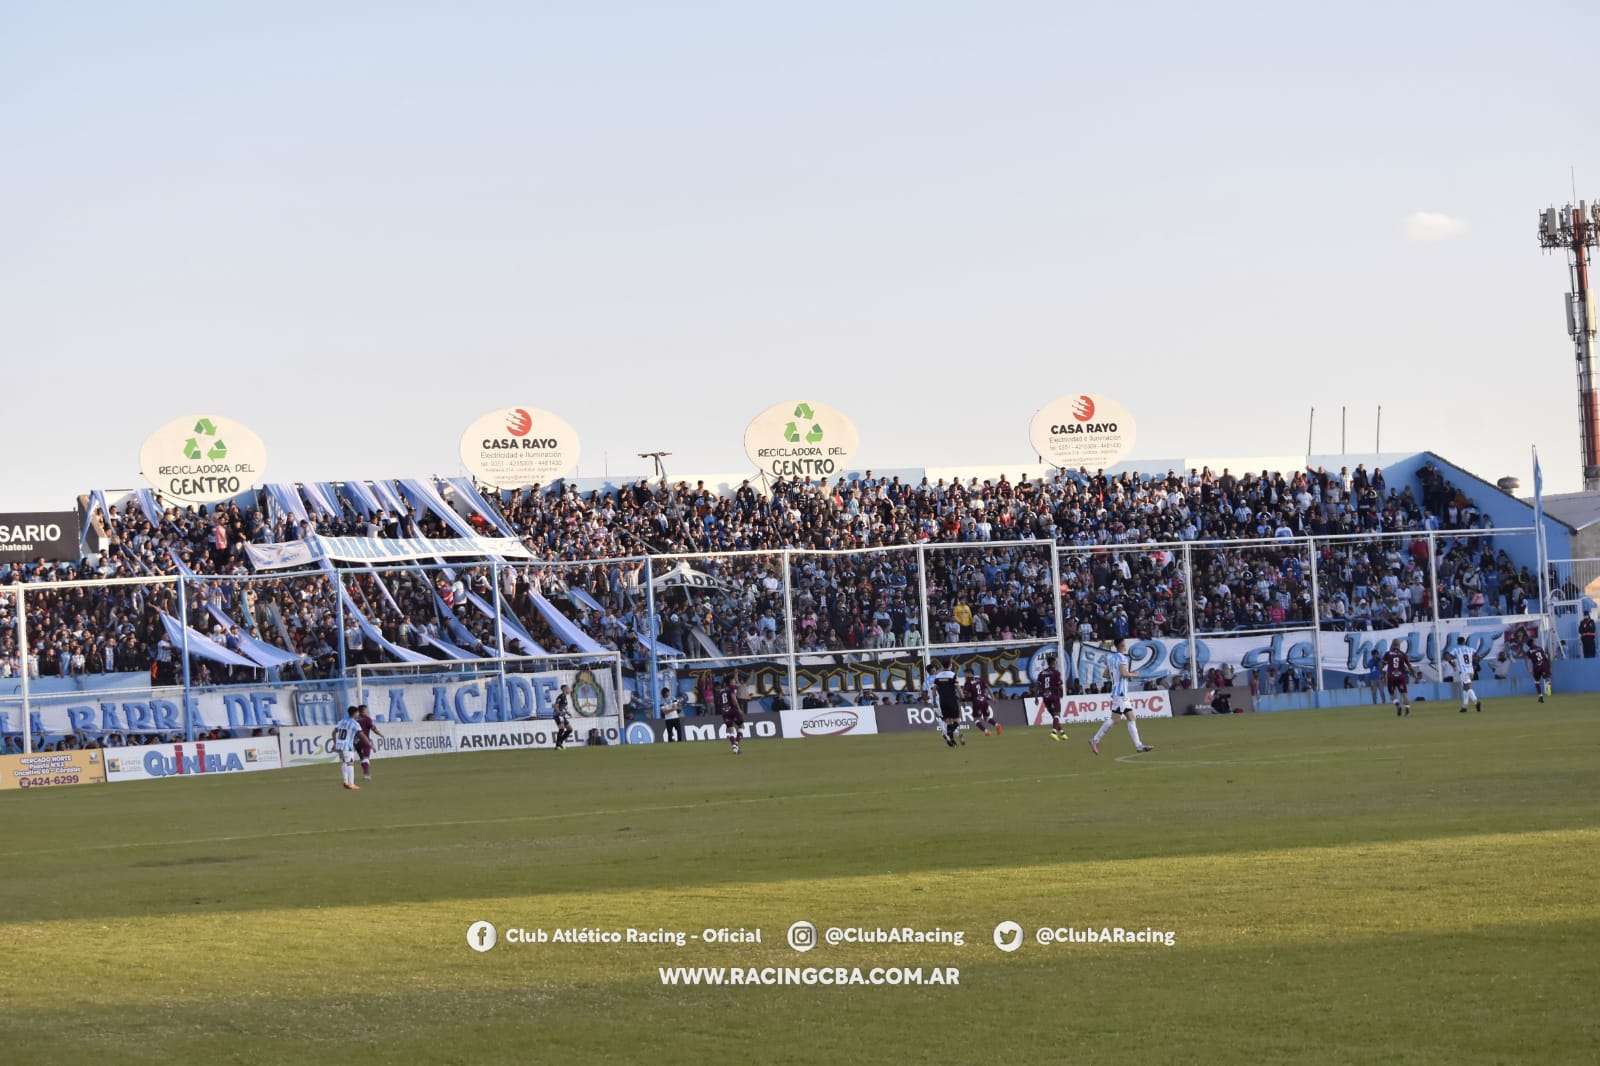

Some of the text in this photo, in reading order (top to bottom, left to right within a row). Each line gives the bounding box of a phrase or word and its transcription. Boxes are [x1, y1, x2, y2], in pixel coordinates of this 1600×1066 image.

[1051, 423, 1117, 434] CASA RAYO
[482, 438, 557, 449] CASA RAYO
[758, 447, 846, 457] RECICLADORA DEL
[158, 463, 255, 475] RECICLADORA DEL
[772, 458, 835, 476] CENTRO
[170, 476, 240, 495] CENTRO
[0, 524, 61, 542] SARIO
[1044, 676, 1051, 689] 8
[432, 676, 558, 724] ACADE
[721, 692, 729, 704] 6
[223, 692, 277, 726] DE
[377, 735, 452, 751] PURA Y SEGURA
[460, 732, 546, 749] ARMANDO
[31, 774, 79, 786] 424-6299
